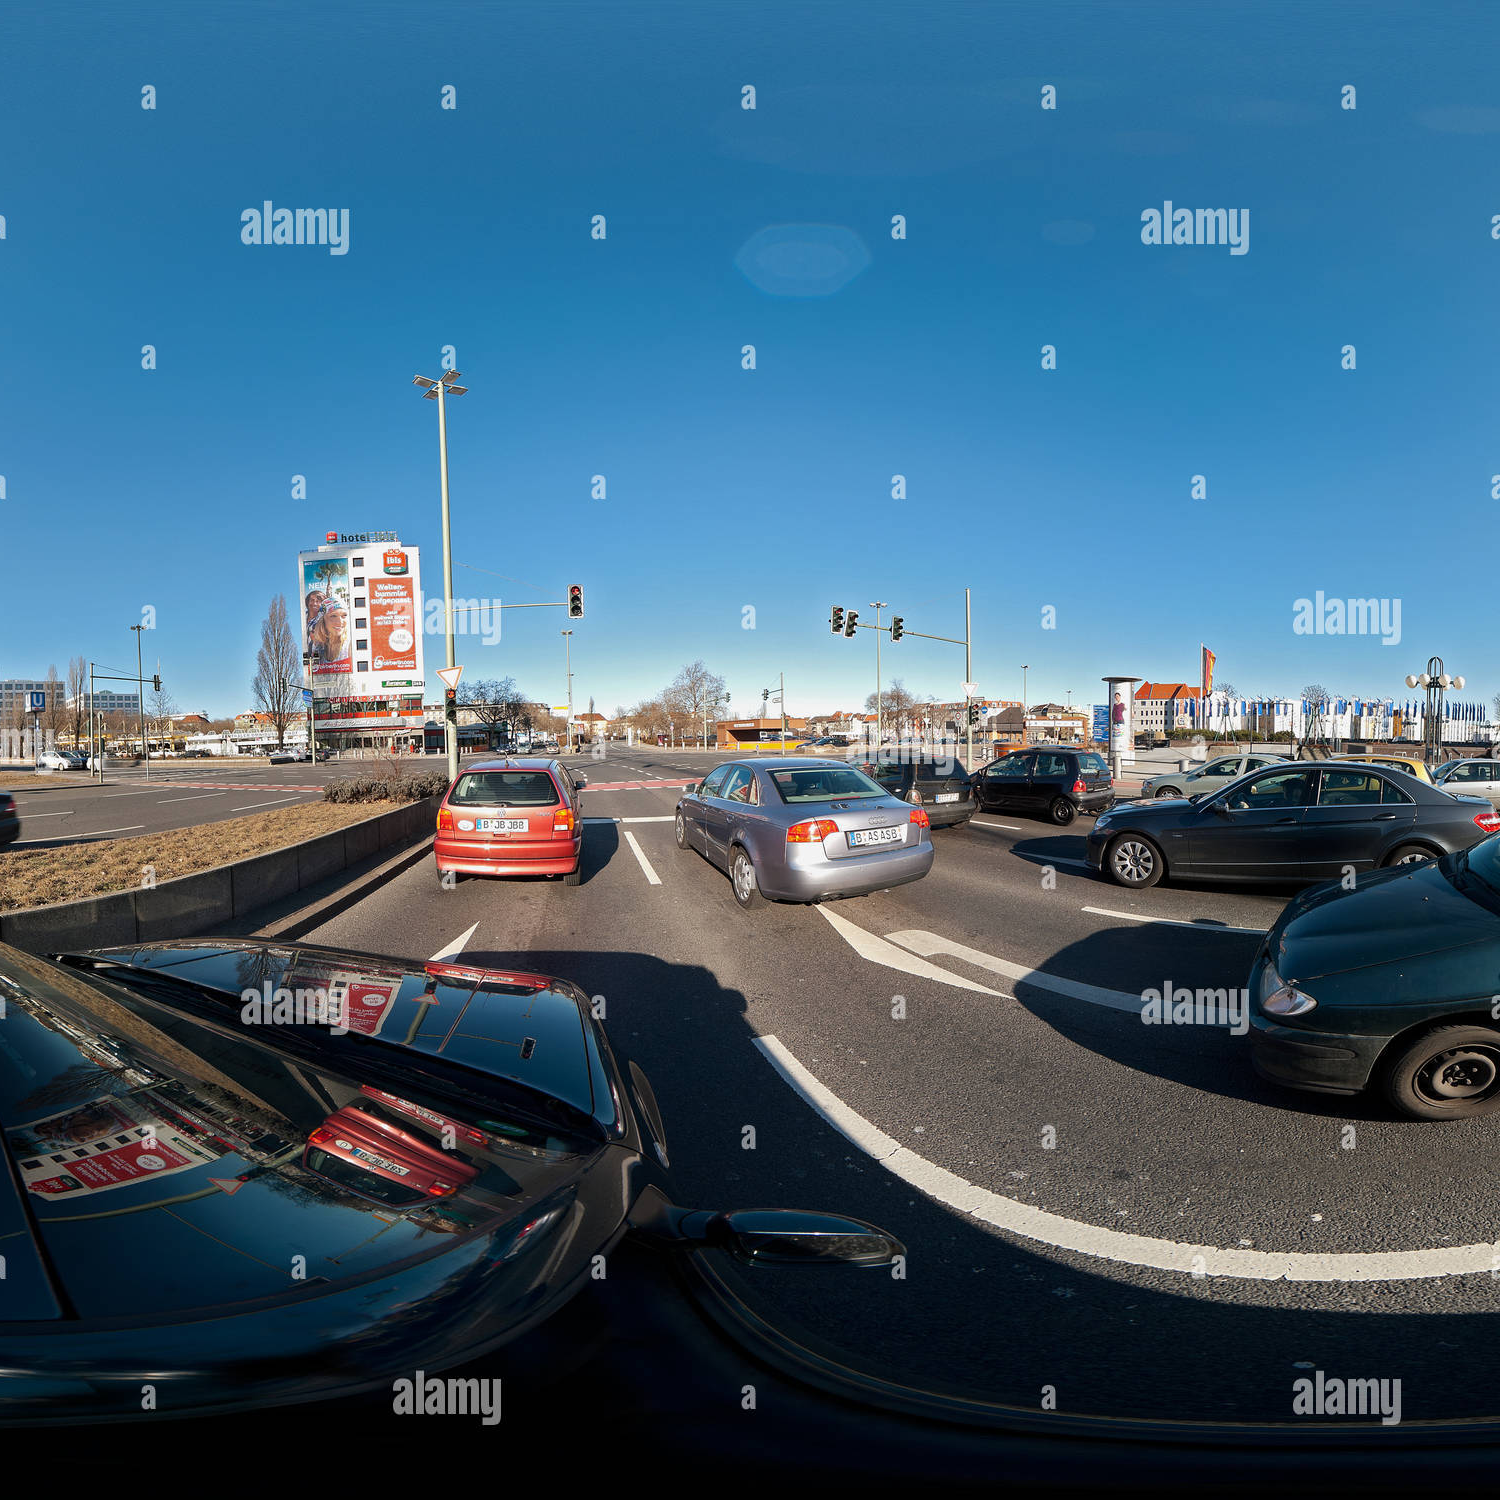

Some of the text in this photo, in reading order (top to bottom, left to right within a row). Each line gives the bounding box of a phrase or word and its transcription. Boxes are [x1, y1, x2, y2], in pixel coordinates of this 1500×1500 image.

[341, 534, 370, 542] hotel
[387, 556, 402, 564] ibis
[33, 693, 43, 706] U
[856, 833, 862, 843] B
